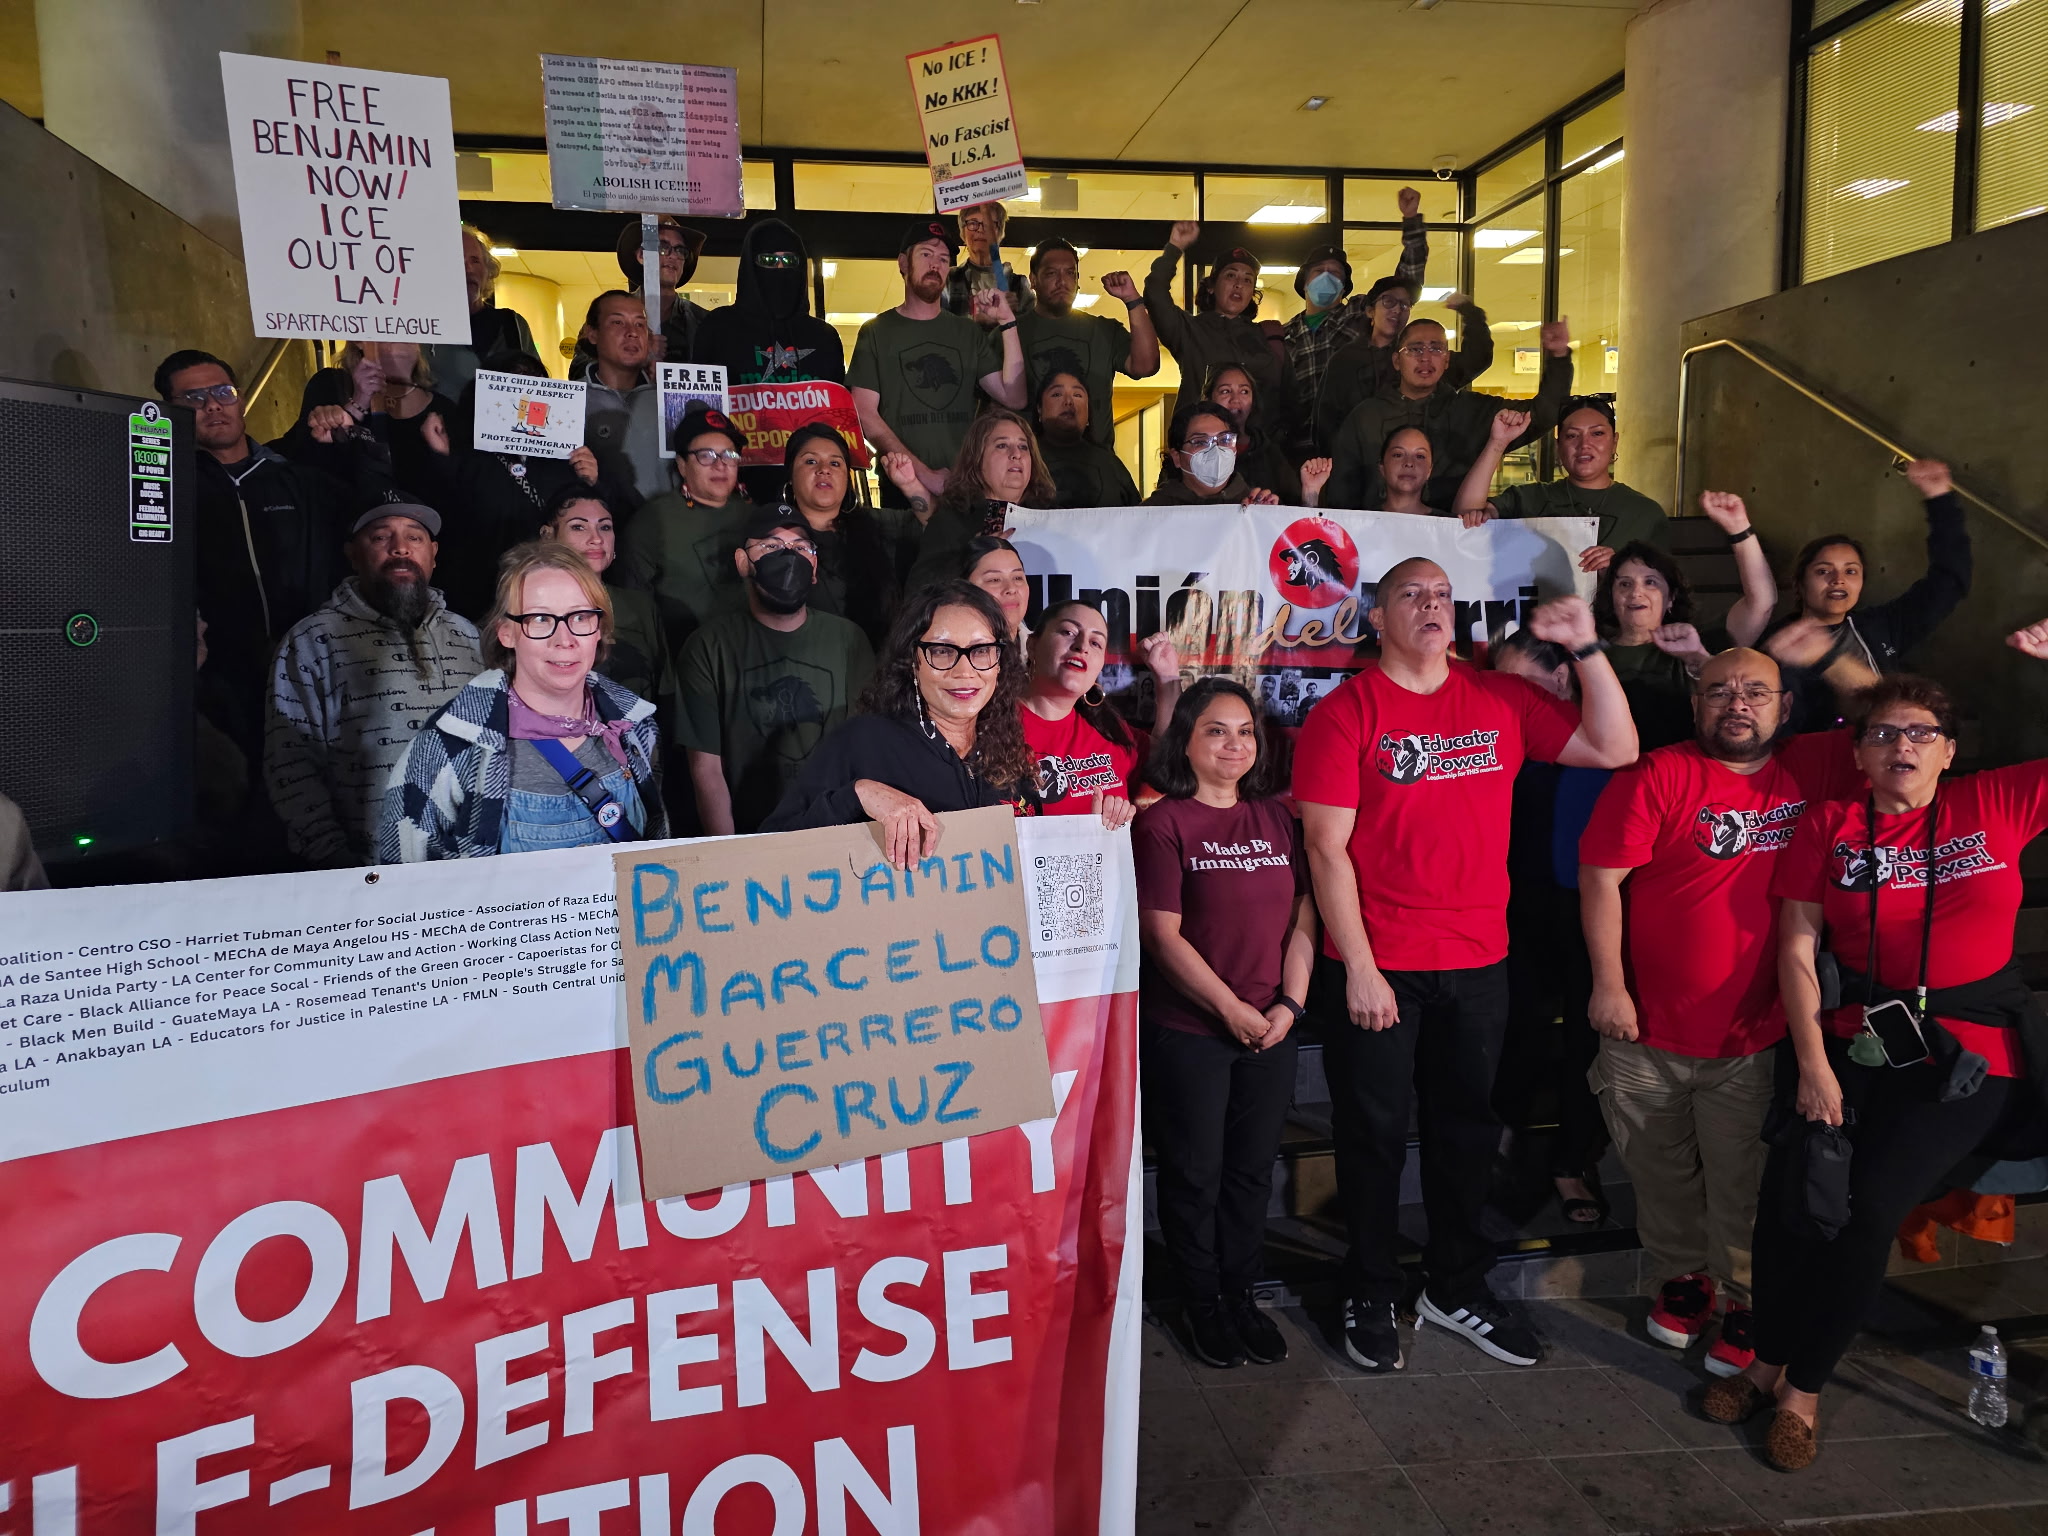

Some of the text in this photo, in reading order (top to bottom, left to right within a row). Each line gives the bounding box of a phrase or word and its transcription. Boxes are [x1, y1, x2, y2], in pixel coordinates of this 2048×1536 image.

[923, 61, 942, 77] No
[949, 50, 975, 71] ICE
[577, 76, 615, 85] GESTAPO
[646, 80, 693, 92] kidnapping
[925, 92, 947, 110] No
[952, 80, 988, 102] KKK
[288, 78, 385, 126] FREE
[632, 108, 728, 123] ICE Kidnapping
[253, 119, 431, 167] BENJAMIN
[929, 116, 1010, 149] No Fascist
[604, 160, 646, 170] obviously
[952, 144, 995, 166] U.S.A.
[307, 164, 408, 200] NOW!
[593, 177, 650, 189] ABOLISH
[939, 170, 1022, 195] Freedom Socialist
[593, 191, 616, 200] pueblo
[640, 194, 660, 202] jamás
[943, 183, 1022, 206] Party Socialism.com
[321, 203, 390, 239] ICE
[288, 238, 414, 274] OUT OF
[335, 275, 400, 305] LA!
[266, 312, 442, 336] SPARTACIST LEAGUE
[478, 373, 585, 392] EVERY CHILD DESERVES
[663, 368, 722, 383] FREE
[663, 382, 722, 392] BENJAMIN
[488, 384, 524, 395] SAFETY
[536, 390, 575, 400] RESPECT
[729, 386, 830, 412] EDUCACIÓN
[134, 425, 168, 434] THUMP
[730, 412, 756, 431] NO
[481, 433, 578, 450] PROTECT IMMIGRANT
[504, 444, 554, 455] STUDENTS!
[134, 450, 168, 466] 1400W
[146, 466, 164, 474] POWER
[1249, 597, 1367, 655] del
[1420, 729, 1499, 753] Educator
[1056, 753, 1112, 772] Educator
[1430, 746, 1497, 773] Power!
[1067, 766, 1119, 790] Power!
[1426, 771, 1457, 780] Leadership
[1466, 767, 1479, 775] THIS
[1740, 800, 1807, 829] Educator
[1202, 839, 1272, 856] Made By
[1747, 826, 1797, 849] Powe
[1884, 831, 1986, 864] Educator
[1190, 853, 1290, 872] Immigrant
[1894, 847, 1994, 882] Power!
[1952, 870, 1972, 880] THIS
[632, 843, 1014, 948] BENJAMIN
[78, 896, 590, 958] Centro CSO Harriet Tubman Center for Social Justice Association of Raza
[19, 908, 620, 985] de Santee High School MEChA de Maya Angelou HS MEChA de Contreras HS MEChA
[20, 929, 592, 1006] Raza Unida Party LA Center for Community Law and Action Working Class Action
[641, 924, 1020, 1026] MARCELO
[23, 1013, 62, 1027] Care
[79, 1002, 124, 1019] Black
[128, 996, 191, 1013] Alliance
[195, 991, 218, 1004] for
[222, 986, 266, 1000] Peace
[270, 977, 310, 993] Socal
[323, 970, 374, 986] Friends
[377, 966, 392, 979] of
[395, 965, 417, 977] the
[420, 961, 459, 973] Green
[462, 955, 505, 968] Grocer
[590, 943, 608, 953] for
[19, 959, 608, 1049] Black Men Build GuateMaya LA Rosemead Tenant's Union People's Struggle for
[14, 975, 596, 1071] LA Anakbayan LA Educators for Justice in Palestine LA FMLN South Central
[644, 994, 1022, 1104] GUERRERO
[754, 1060, 982, 1164] CRUZ
